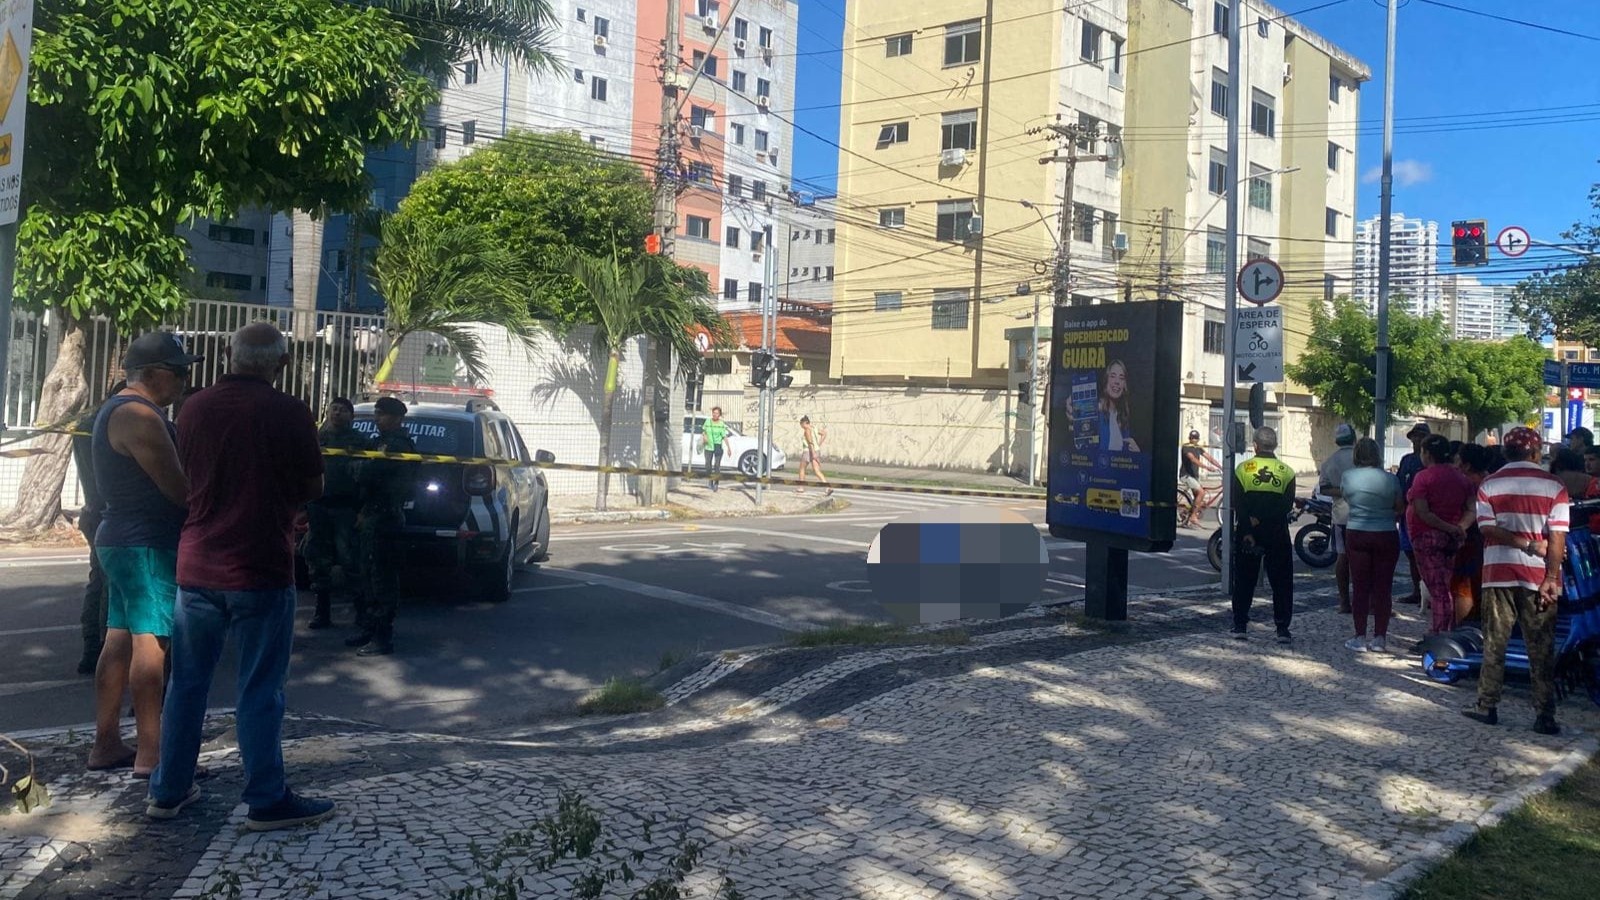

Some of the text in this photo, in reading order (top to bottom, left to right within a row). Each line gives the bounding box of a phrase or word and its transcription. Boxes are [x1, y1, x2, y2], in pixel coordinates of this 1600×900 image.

[1266, 310, 1279, 318] DE
[1240, 320, 1278, 329] ESPERA
[1063, 329, 1129, 344] SUPERMERCADO
